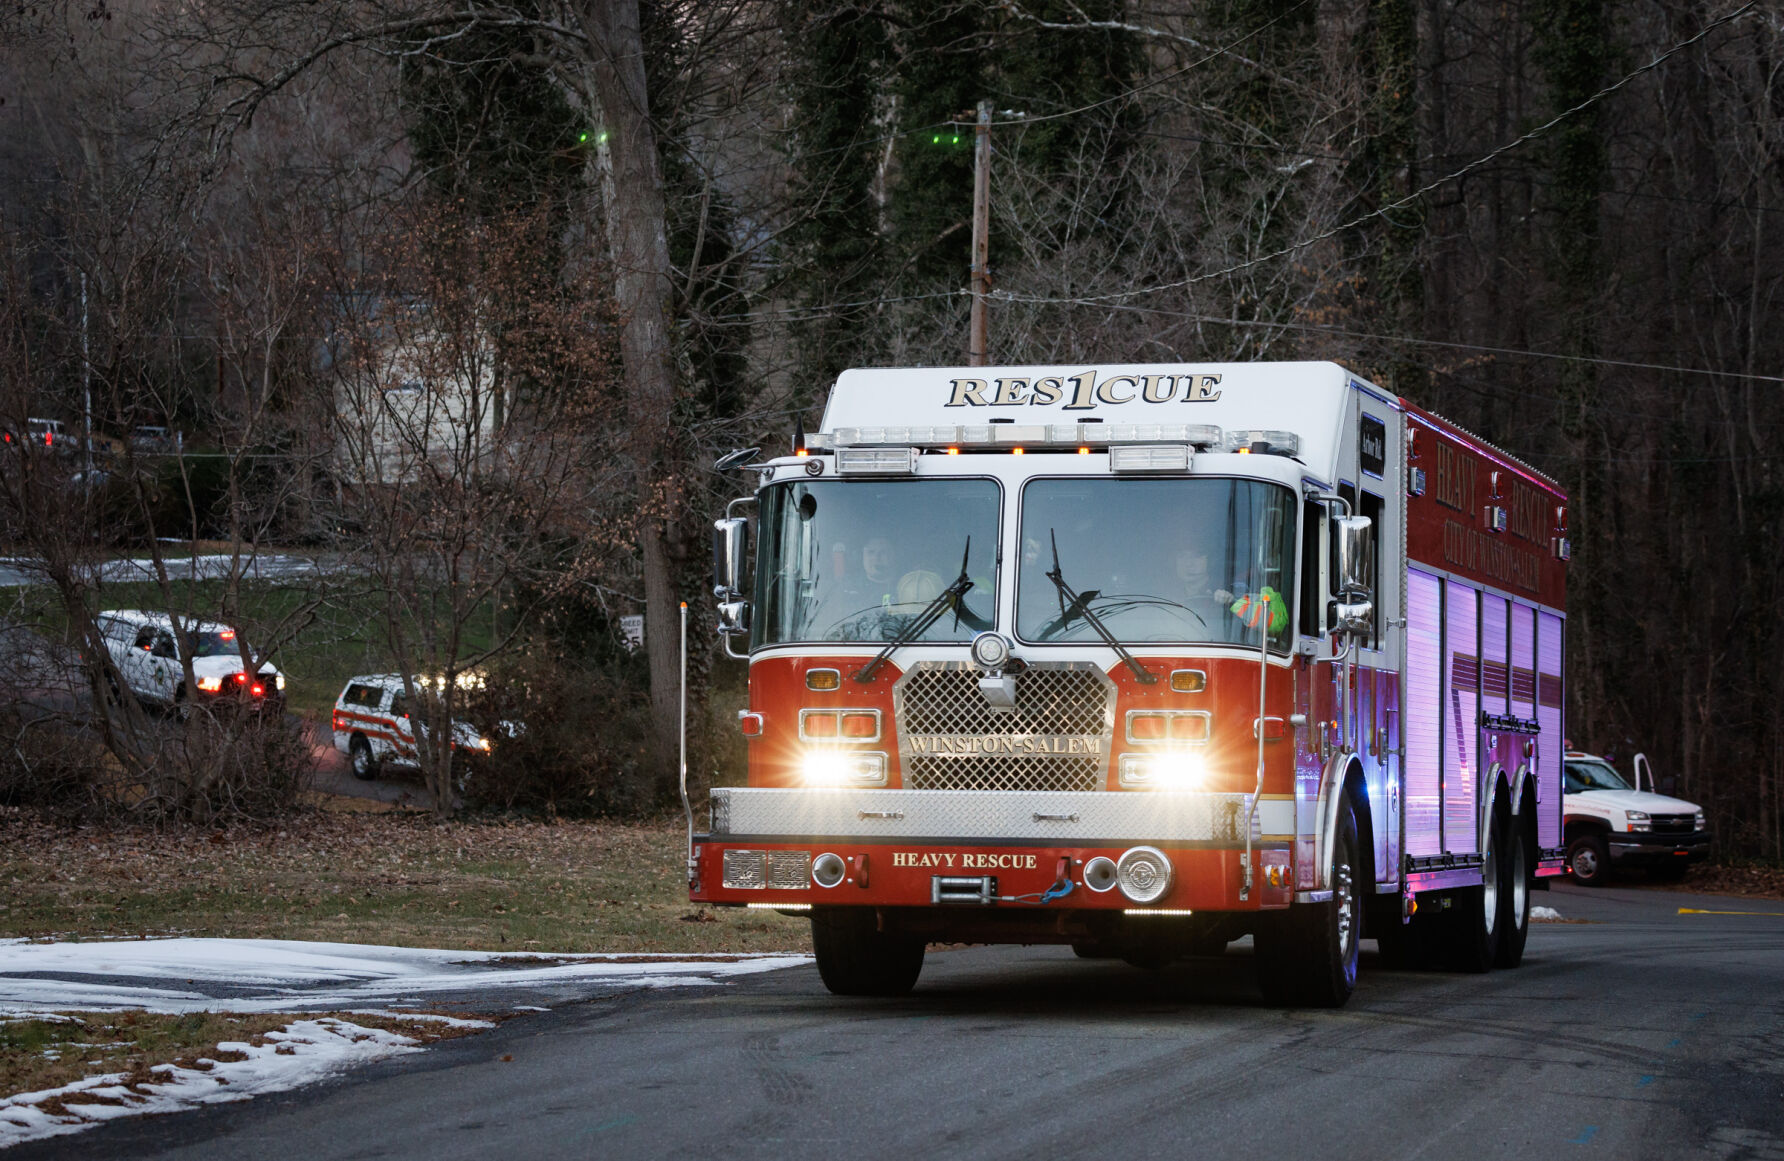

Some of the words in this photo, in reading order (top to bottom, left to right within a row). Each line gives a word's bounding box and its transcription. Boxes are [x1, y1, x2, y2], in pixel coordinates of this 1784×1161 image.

[1436, 440, 1479, 519] HEAVY
[908, 736, 1101, 754] WINSTON-SALEM
[892, 852, 957, 868] HEAVY
[961, 853, 1037, 869] RESCUE
